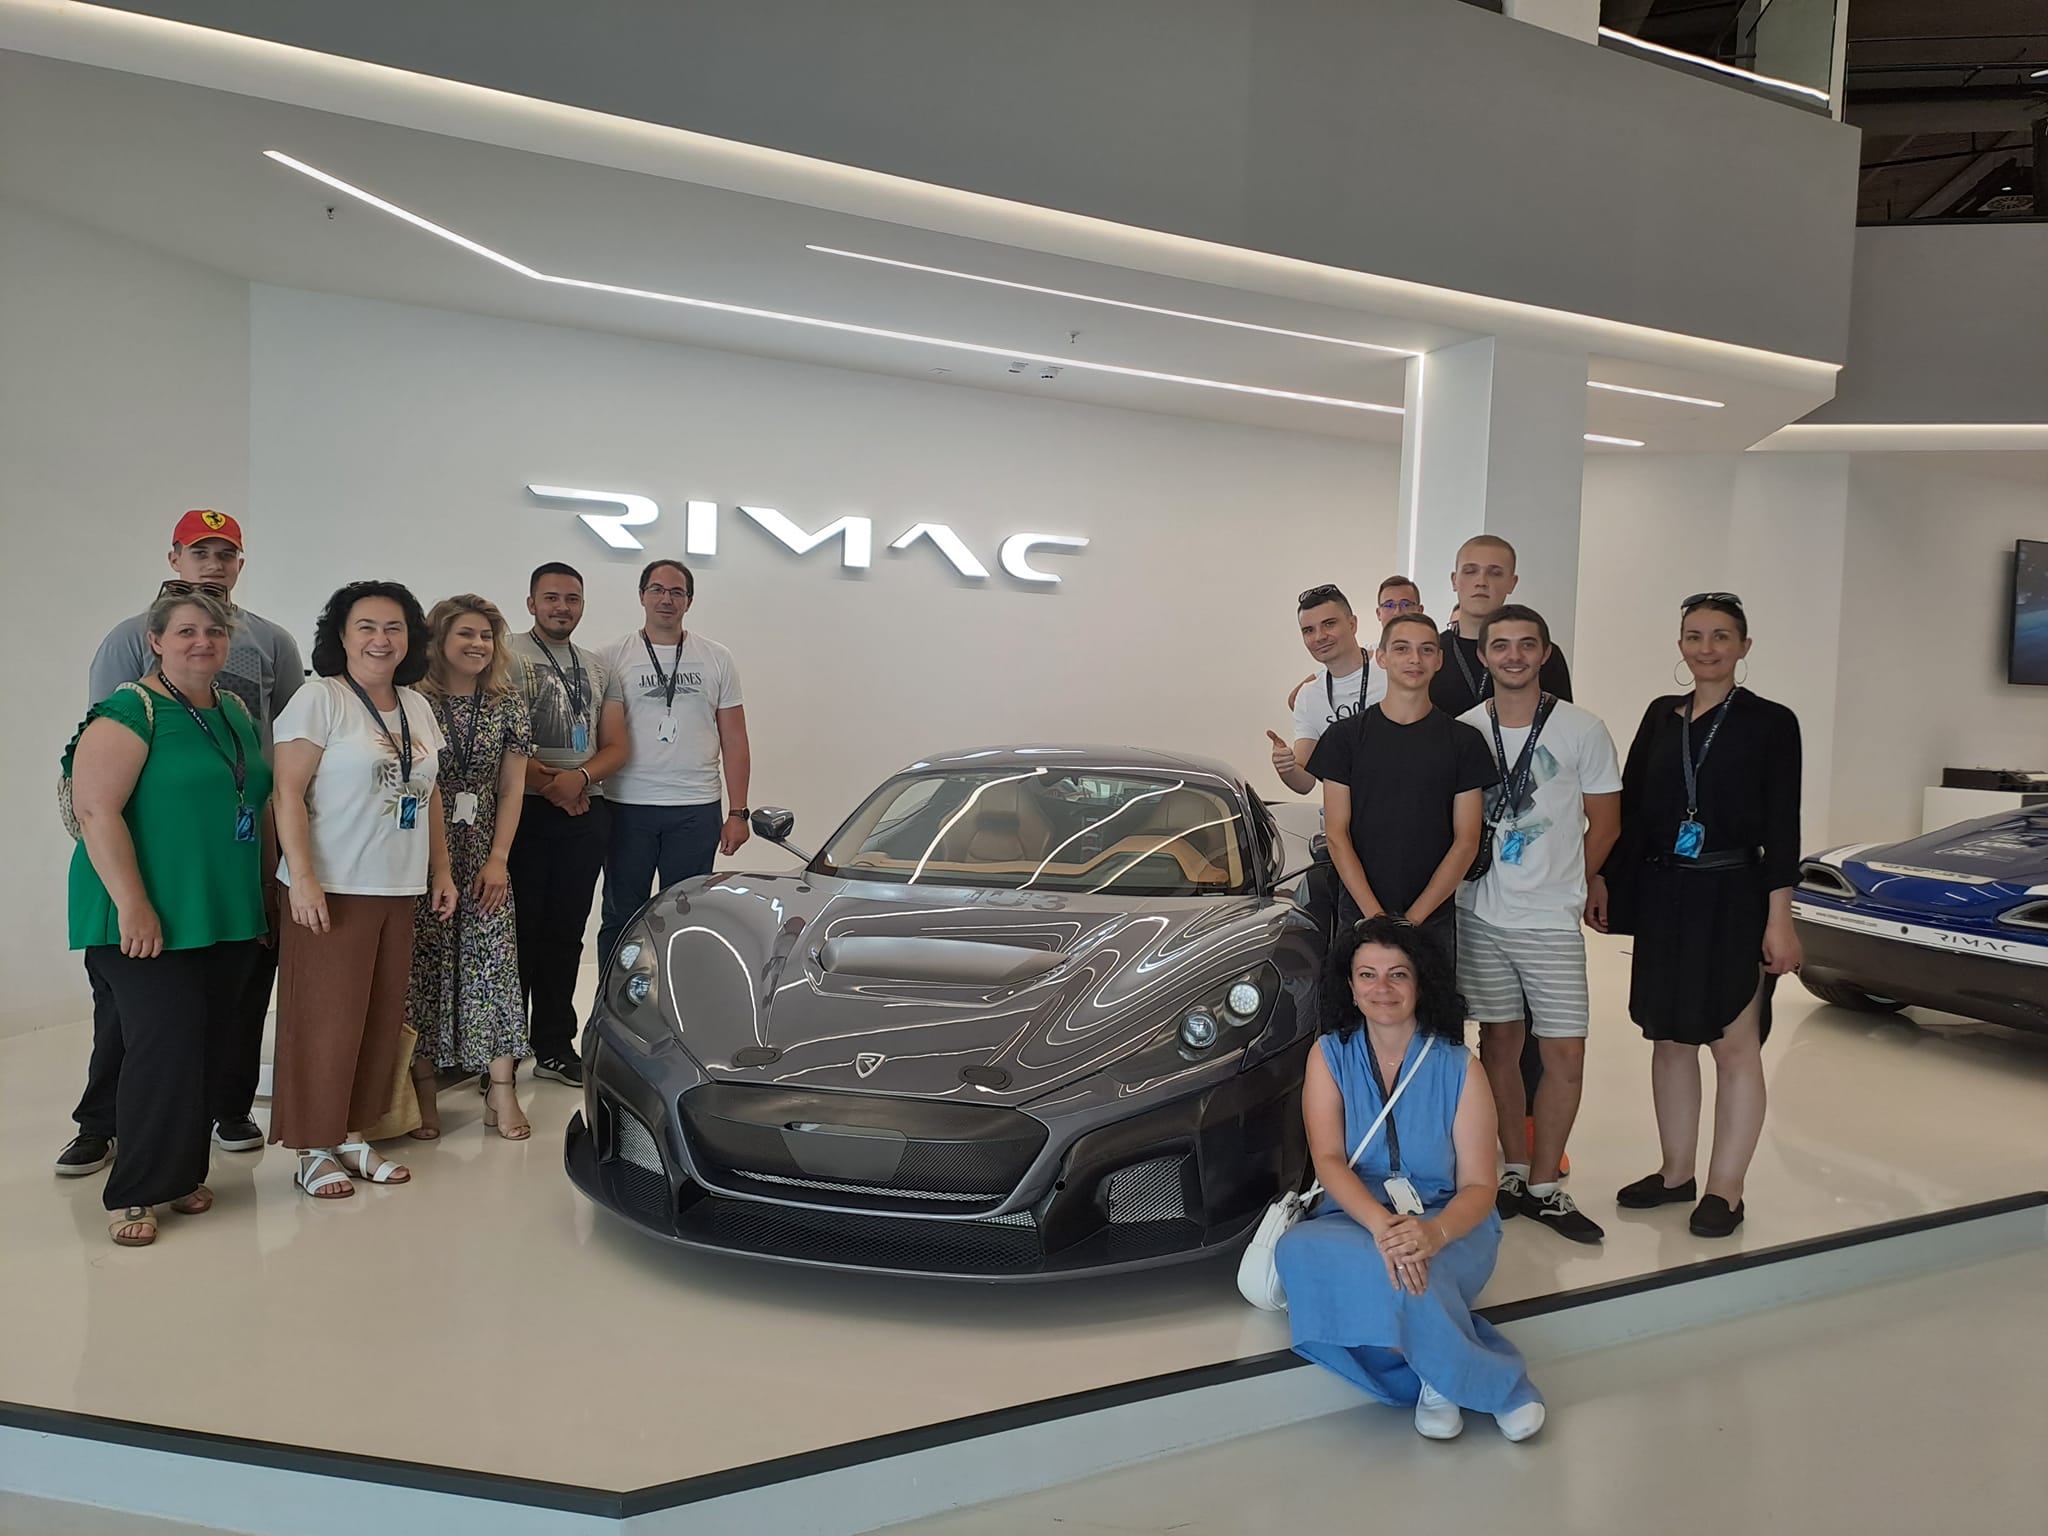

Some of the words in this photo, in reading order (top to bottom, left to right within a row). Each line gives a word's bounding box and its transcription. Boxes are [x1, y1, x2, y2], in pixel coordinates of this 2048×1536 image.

[525, 484, 1091, 582] RIMAC
[675, 672, 702, 686] ONES
[1933, 932, 2017, 953] RIMAC
